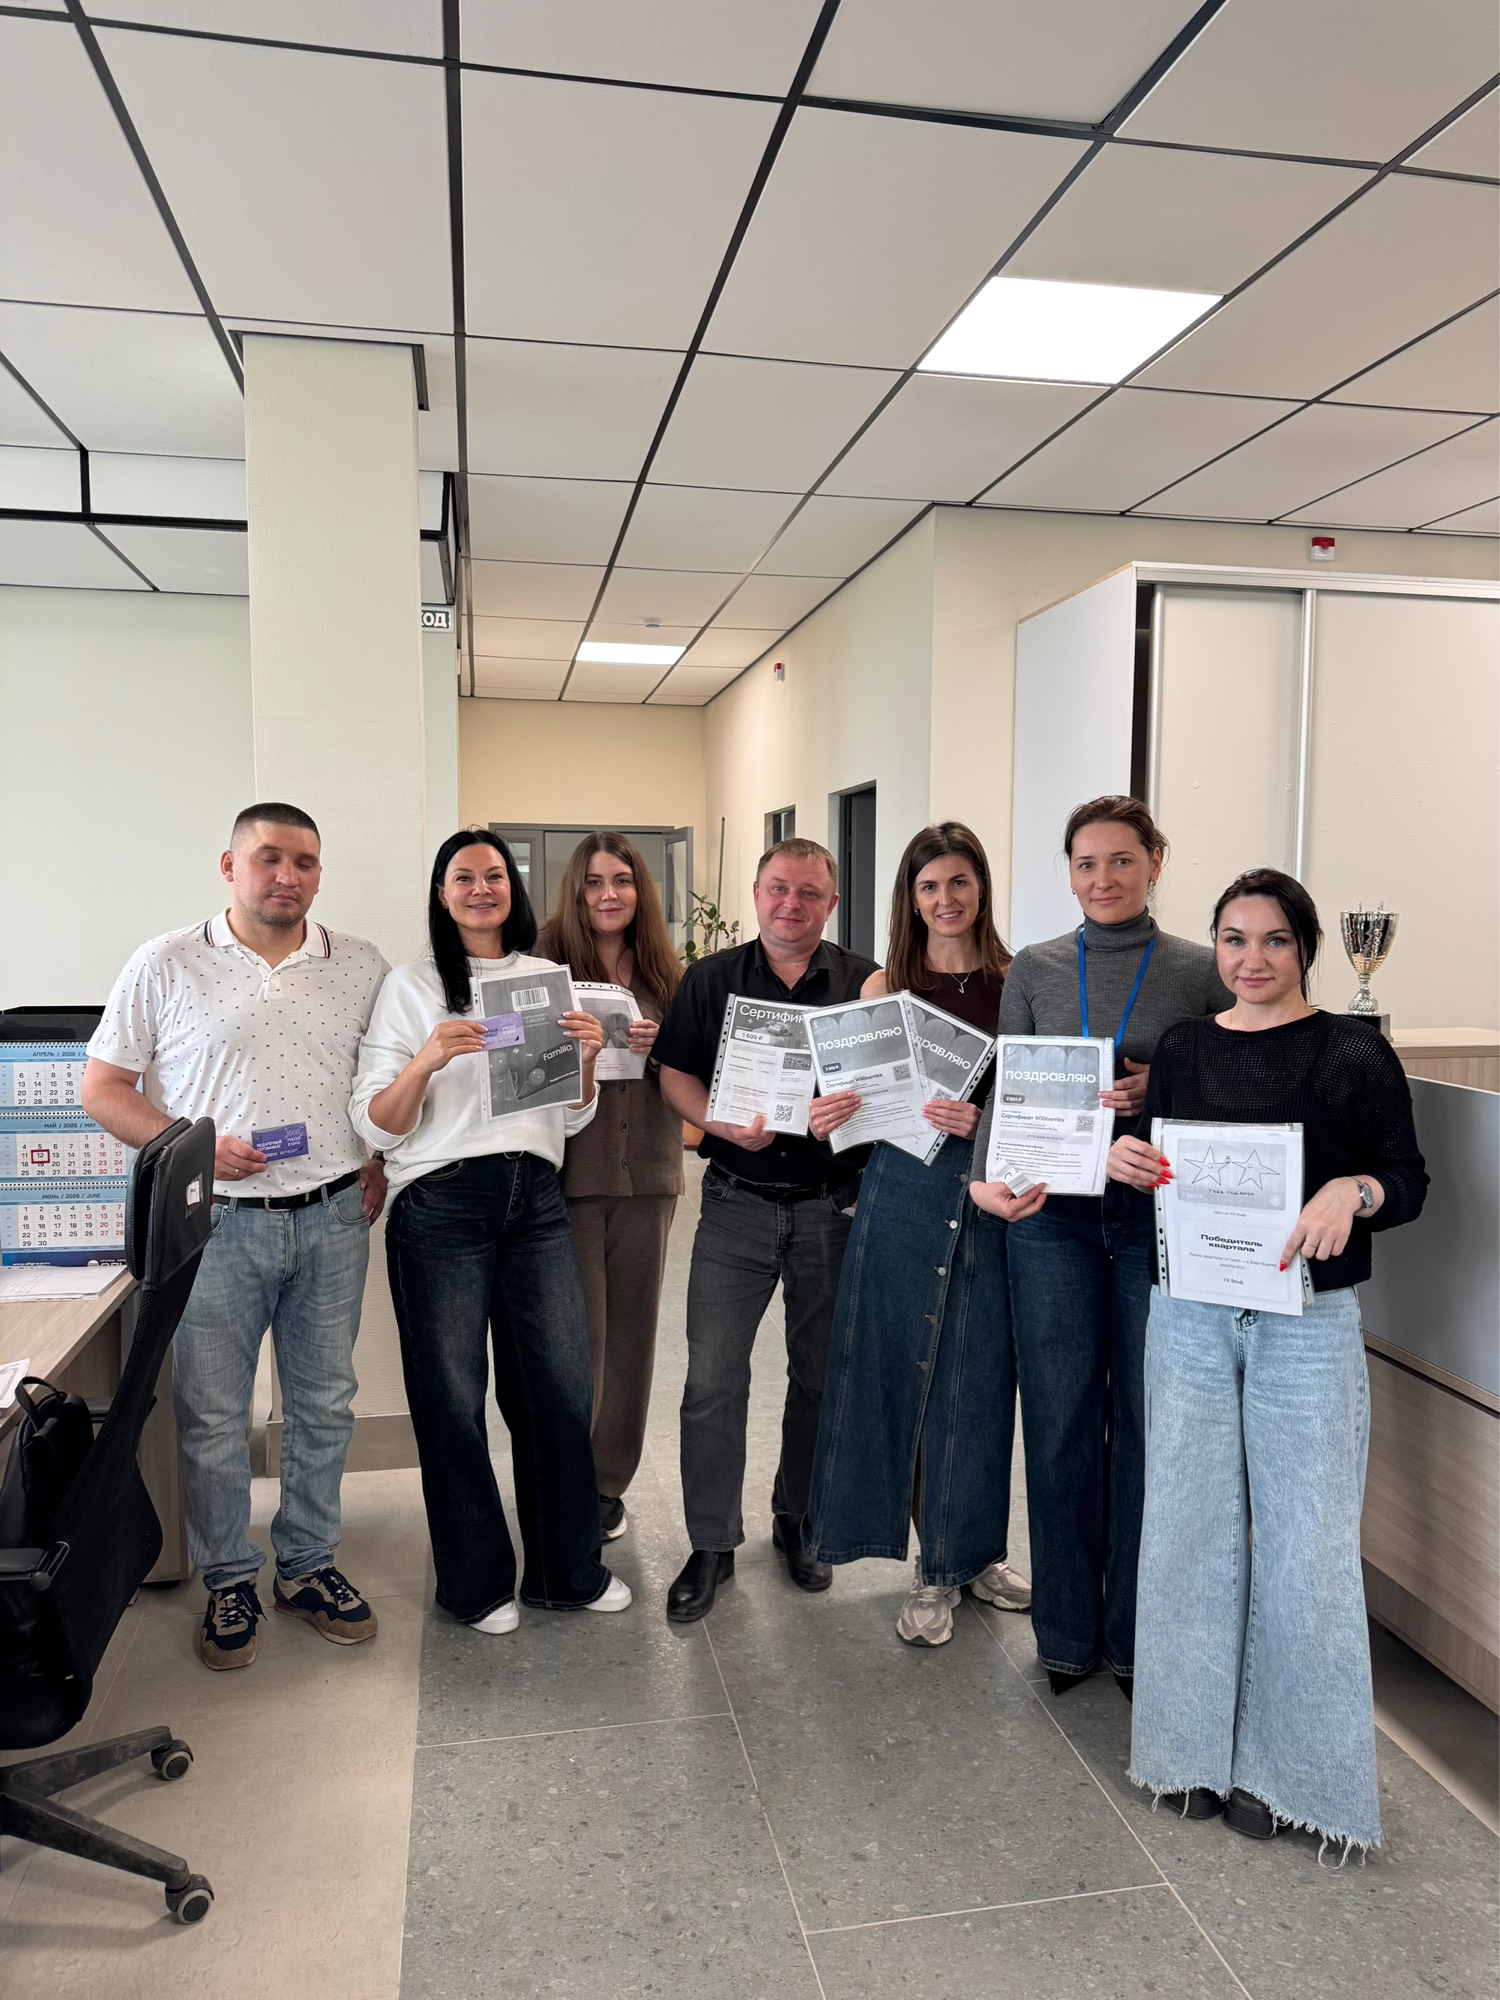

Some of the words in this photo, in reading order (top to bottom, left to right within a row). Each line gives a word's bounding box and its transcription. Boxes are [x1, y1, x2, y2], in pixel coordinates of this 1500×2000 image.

[421, 612, 447, 628] ОД
[818, 1025, 902, 1052] поздравляю
[785, 1056, 810, 1067] OZON
[1005, 1069, 1096, 1084] поздравляю
[826, 1079, 855, 1089] Сертификат
[1001, 1112, 1034, 1121] Сертификат
[1200, 1234, 1263, 1247] Победитель
[1208, 1242, 1255, 1253] квартала
